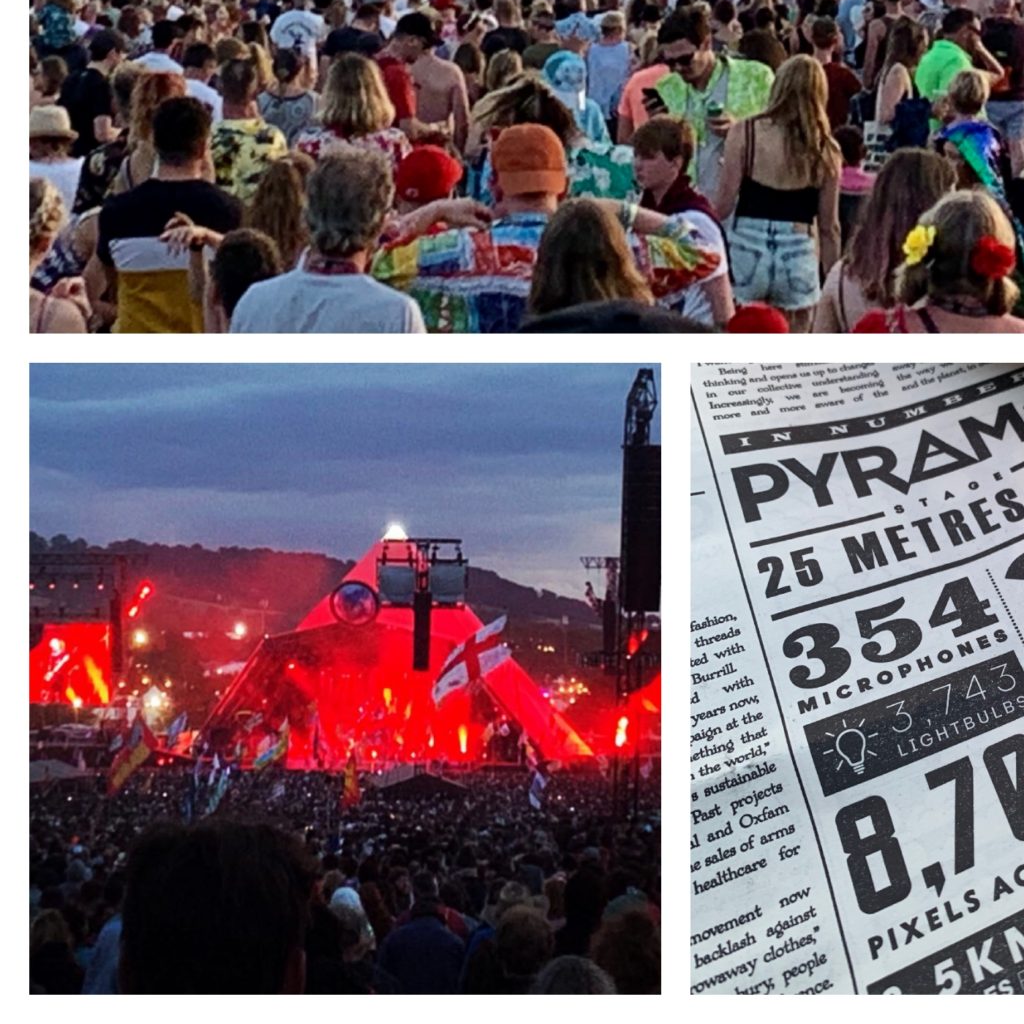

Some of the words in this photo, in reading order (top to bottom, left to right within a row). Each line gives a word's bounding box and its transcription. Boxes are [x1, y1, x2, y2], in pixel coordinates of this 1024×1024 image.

[702, 377, 747, 388] thinking
[749, 374, 768, 383] and
[770, 373, 798, 383] opens
[813, 369, 826, 378] up
[705, 391, 718, 399] in
[728, 389, 747, 397] our
[757, 383, 802, 394] collective
[811, 370, 880, 388] understanding
[718, 366, 748, 376] Being
[760, 363, 783, 372] here
[896, 372, 913, 382] the
[901, 380, 919, 392] and
[920, 377, 936, 387] the
[708, 396, 775, 410] Increasingly,
[785, 393, 801, 401] we
[812, 390, 829, 398] are
[838, 378, 885, 394] becoming
[712, 412, 742, 422] more
[750, 407, 771, 417] and
[779, 404, 807, 414] more
[814, 398, 846, 410] aware
[853, 393, 864, 403] of
[872, 388, 890, 399] the
[738, 431, 793, 448] IN
[893, 471, 1004, 514] STAGE
[756, 546, 824, 599] 25
[690, 613, 737, 632] fashion,
[694, 626, 742, 648] threads
[782, 576, 1000, 690] 354
[713, 642, 746, 659] with
[722, 675, 755, 693] with
[797, 628, 1009, 716] MICROPHONES
[690, 704, 726, 727] years
[728, 695, 760, 712] now,
[886, 662, 1018, 734] 3,743
[725, 717, 740, 732] at
[741, 711, 764, 726] the
[690, 739, 735, 763] ething
[740, 726, 768, 744] that
[698, 763, 721, 778] the
[703, 761, 777, 797] sustainable
[690, 803, 723, 825] Past
[729, 782, 784, 816] projects
[706, 821, 734, 843] and
[738, 804, 790, 829] Oxfam
[704, 846, 737, 868] sales
[739, 834, 756, 852] of
[760, 823, 796, 846] arms
[692, 858, 768, 895] healthcare
[778, 844, 801, 862] for
[778, 886, 811, 909] now
[693, 931, 758, 969] backlash
[766, 905, 818, 940] against
[867, 888, 982, 961] PIXELS
[781, 951, 828, 987] people
